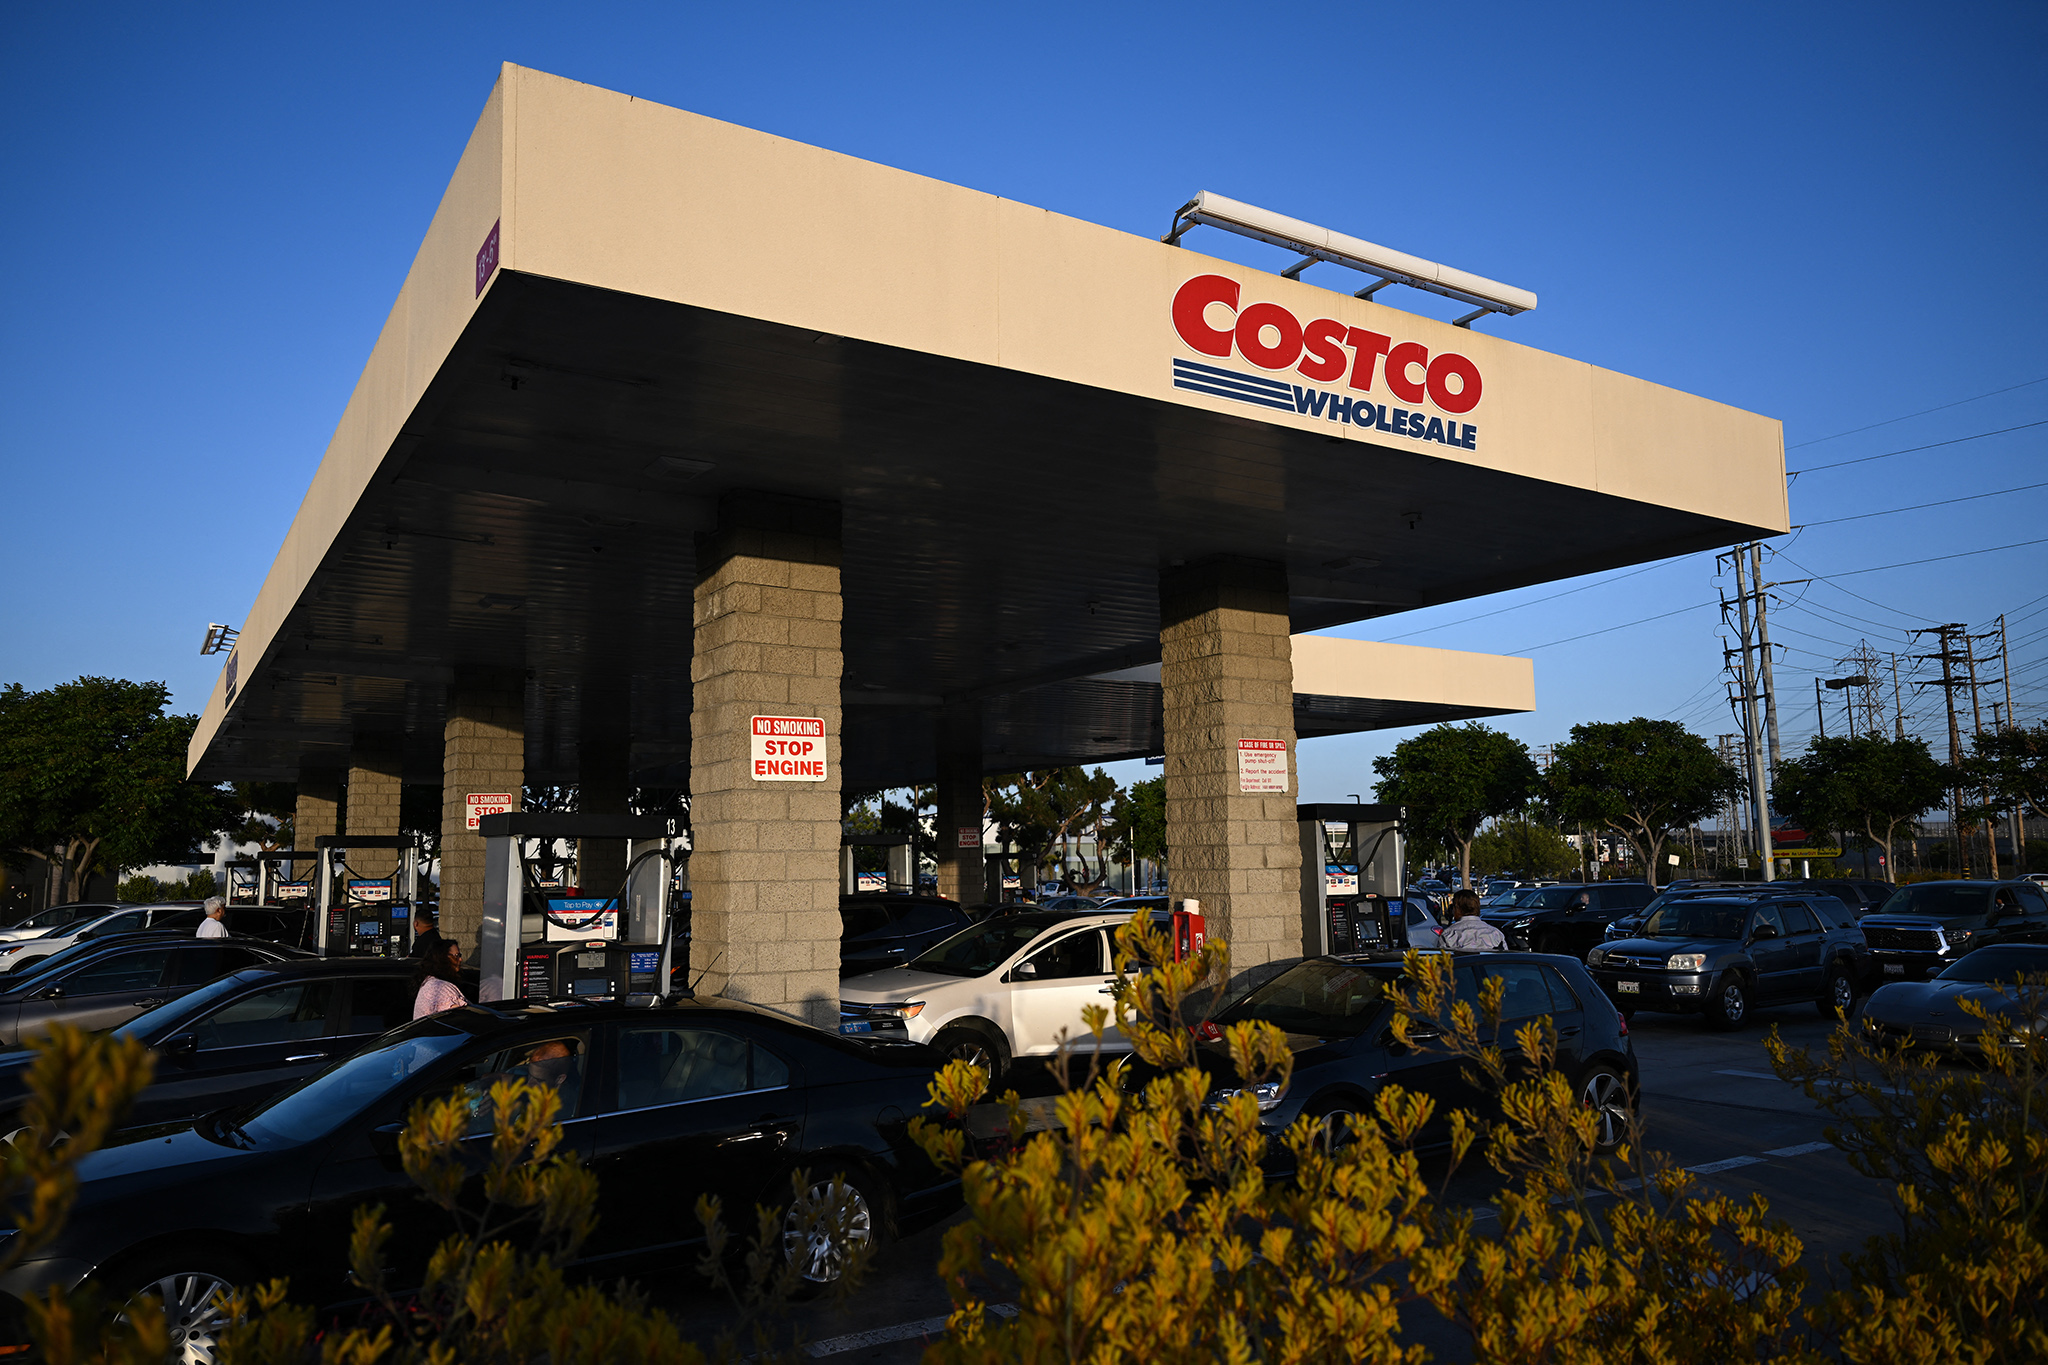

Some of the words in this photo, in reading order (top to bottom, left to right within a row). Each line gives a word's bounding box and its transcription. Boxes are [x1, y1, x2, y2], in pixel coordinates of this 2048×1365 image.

[1171, 274, 1483, 414] COSTCO
[1292, 385, 1477, 451] WHOLESALE
[757, 720, 771, 734] NO
[773, 720, 820, 735] SMOKING
[765, 740, 814, 756] STOP
[755, 760, 824, 775] ENGINE
[474, 806, 505, 815] STOP
[1400, 807, 1406, 819] 15
[666, 818, 676, 835] 13
[564, 901, 573, 909] Tap
[582, 901, 594, 909] Pay
